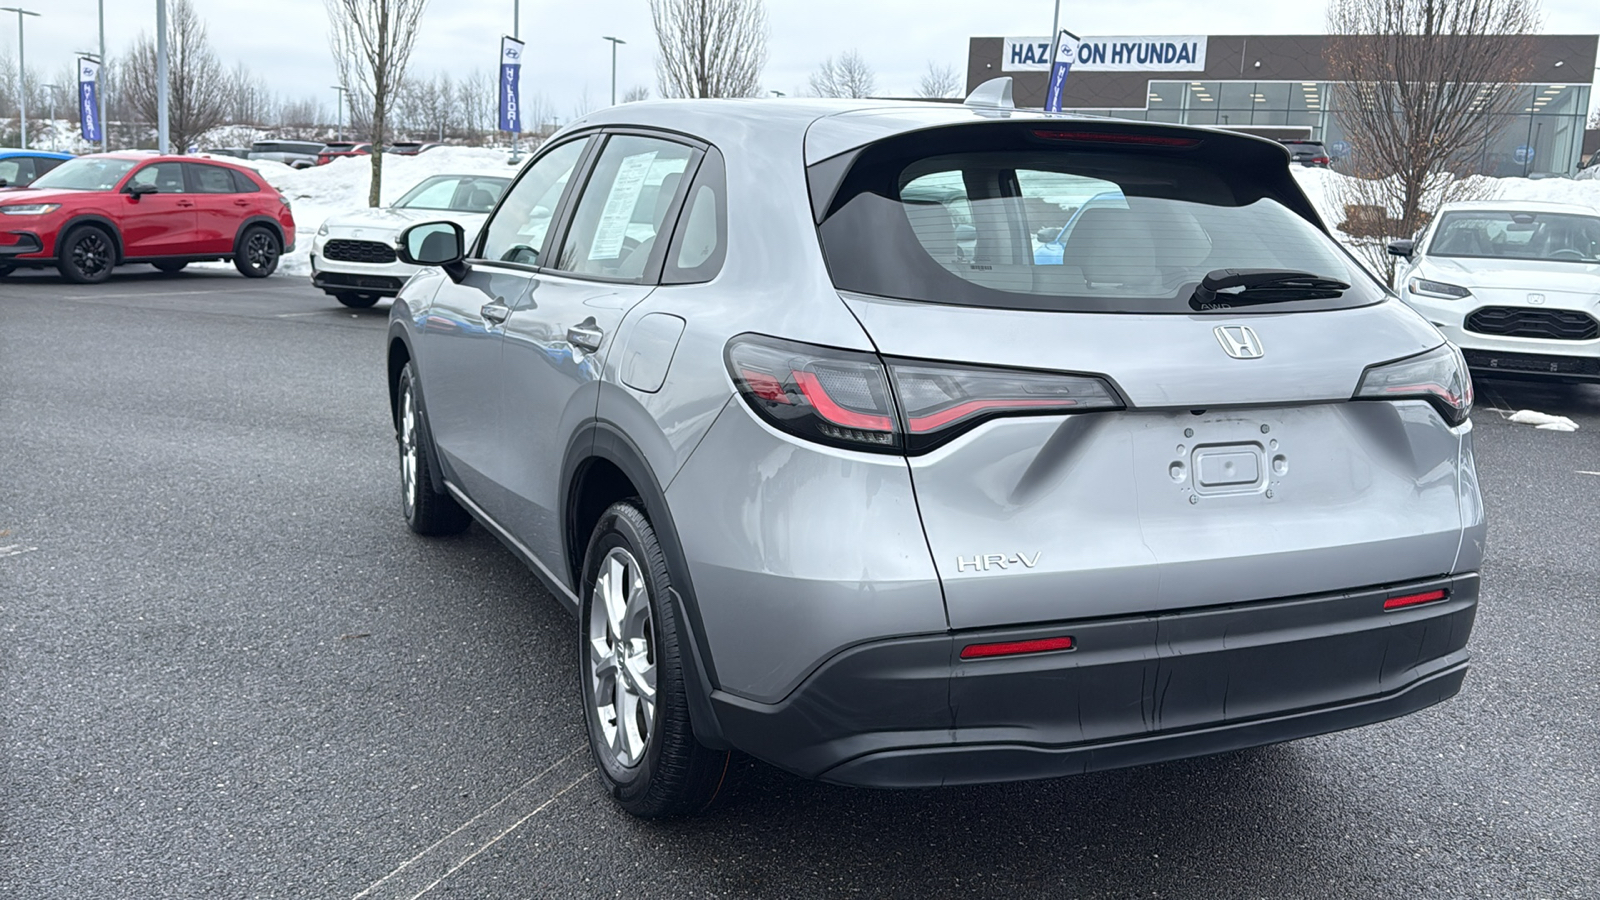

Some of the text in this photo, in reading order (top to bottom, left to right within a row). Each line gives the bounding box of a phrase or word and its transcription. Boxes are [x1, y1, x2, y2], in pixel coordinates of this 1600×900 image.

[1010, 42, 1198, 65] HAZON HYUNDAI
[505, 66, 517, 129] HYUNDAI
[1200, 303, 1232, 311] AWD
[956, 551, 1042, 572] HR-V
